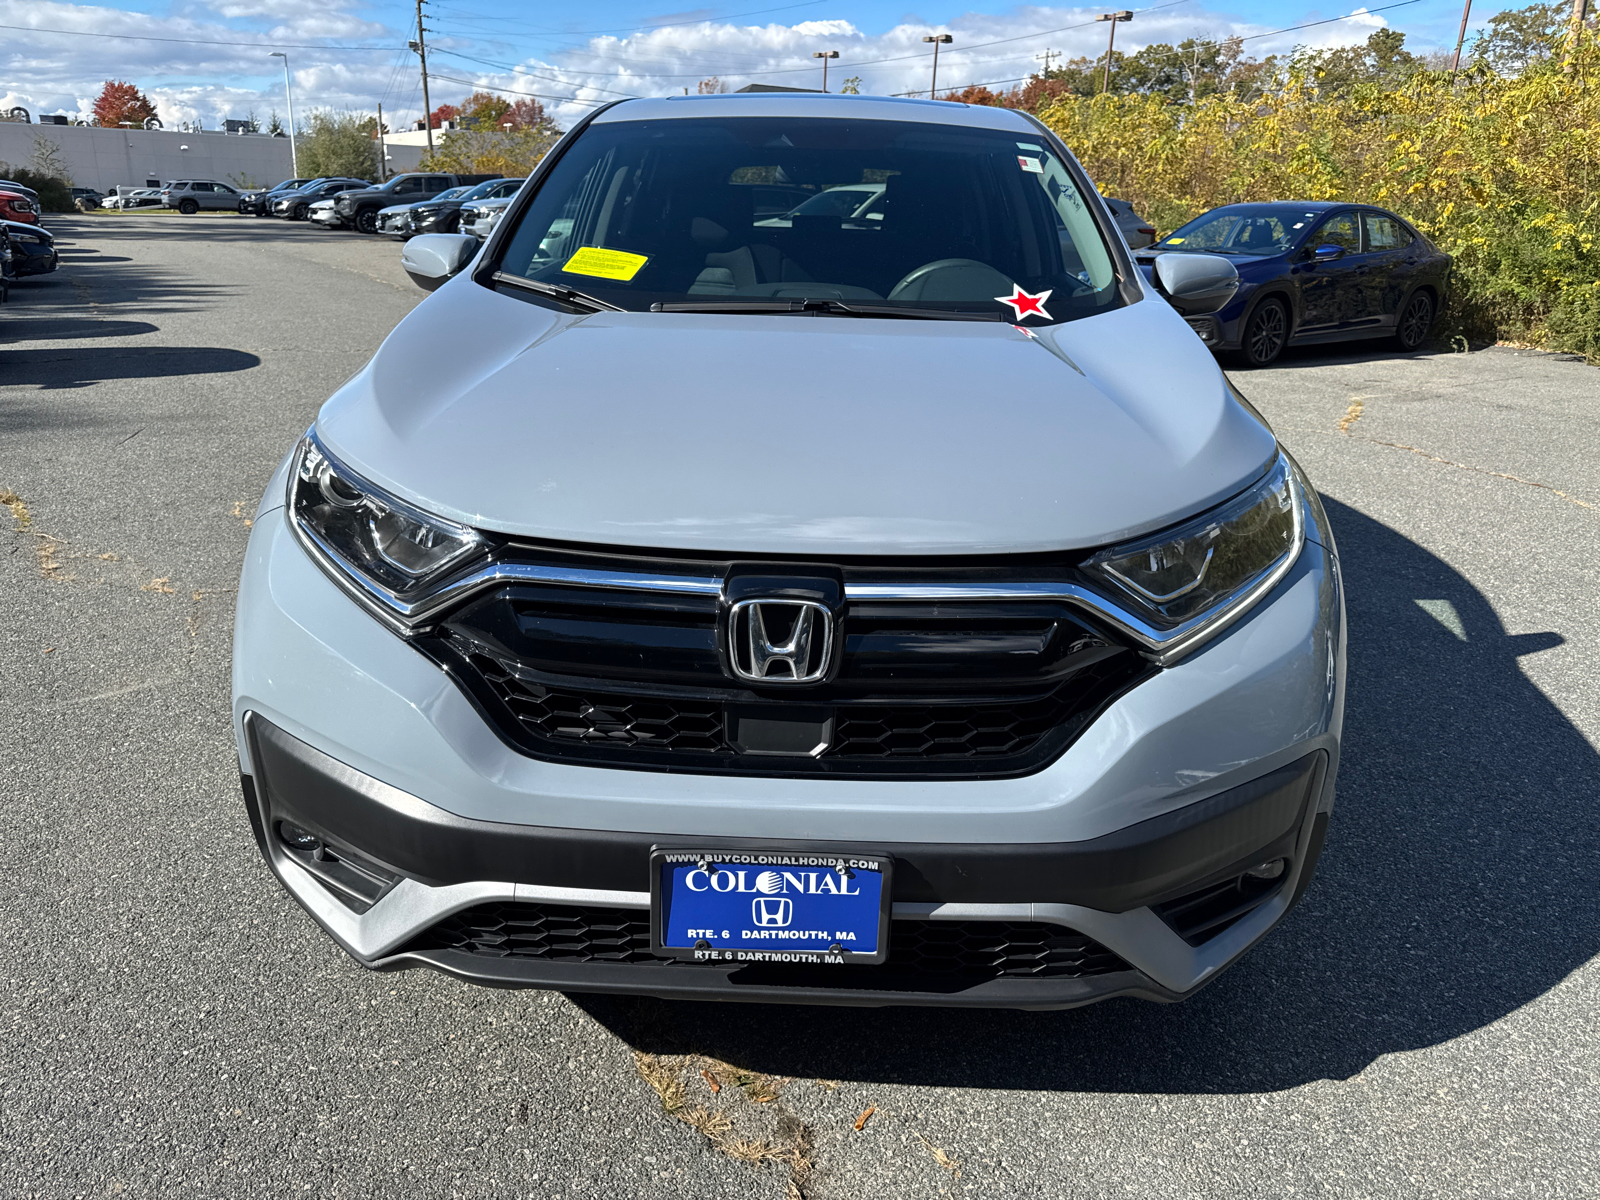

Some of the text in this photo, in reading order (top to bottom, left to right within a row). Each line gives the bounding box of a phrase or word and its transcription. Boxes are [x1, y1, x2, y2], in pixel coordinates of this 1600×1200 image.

[665, 853, 879, 870] WWW.BUYCOLONIALHONDA.COM
[685, 869, 860, 895] COLONIAL
[687, 929, 857, 941] RTE. 6 DARTMOUTH, MA
[694, 950, 845, 964] RTE. 6 DARTMOUTH, MA
